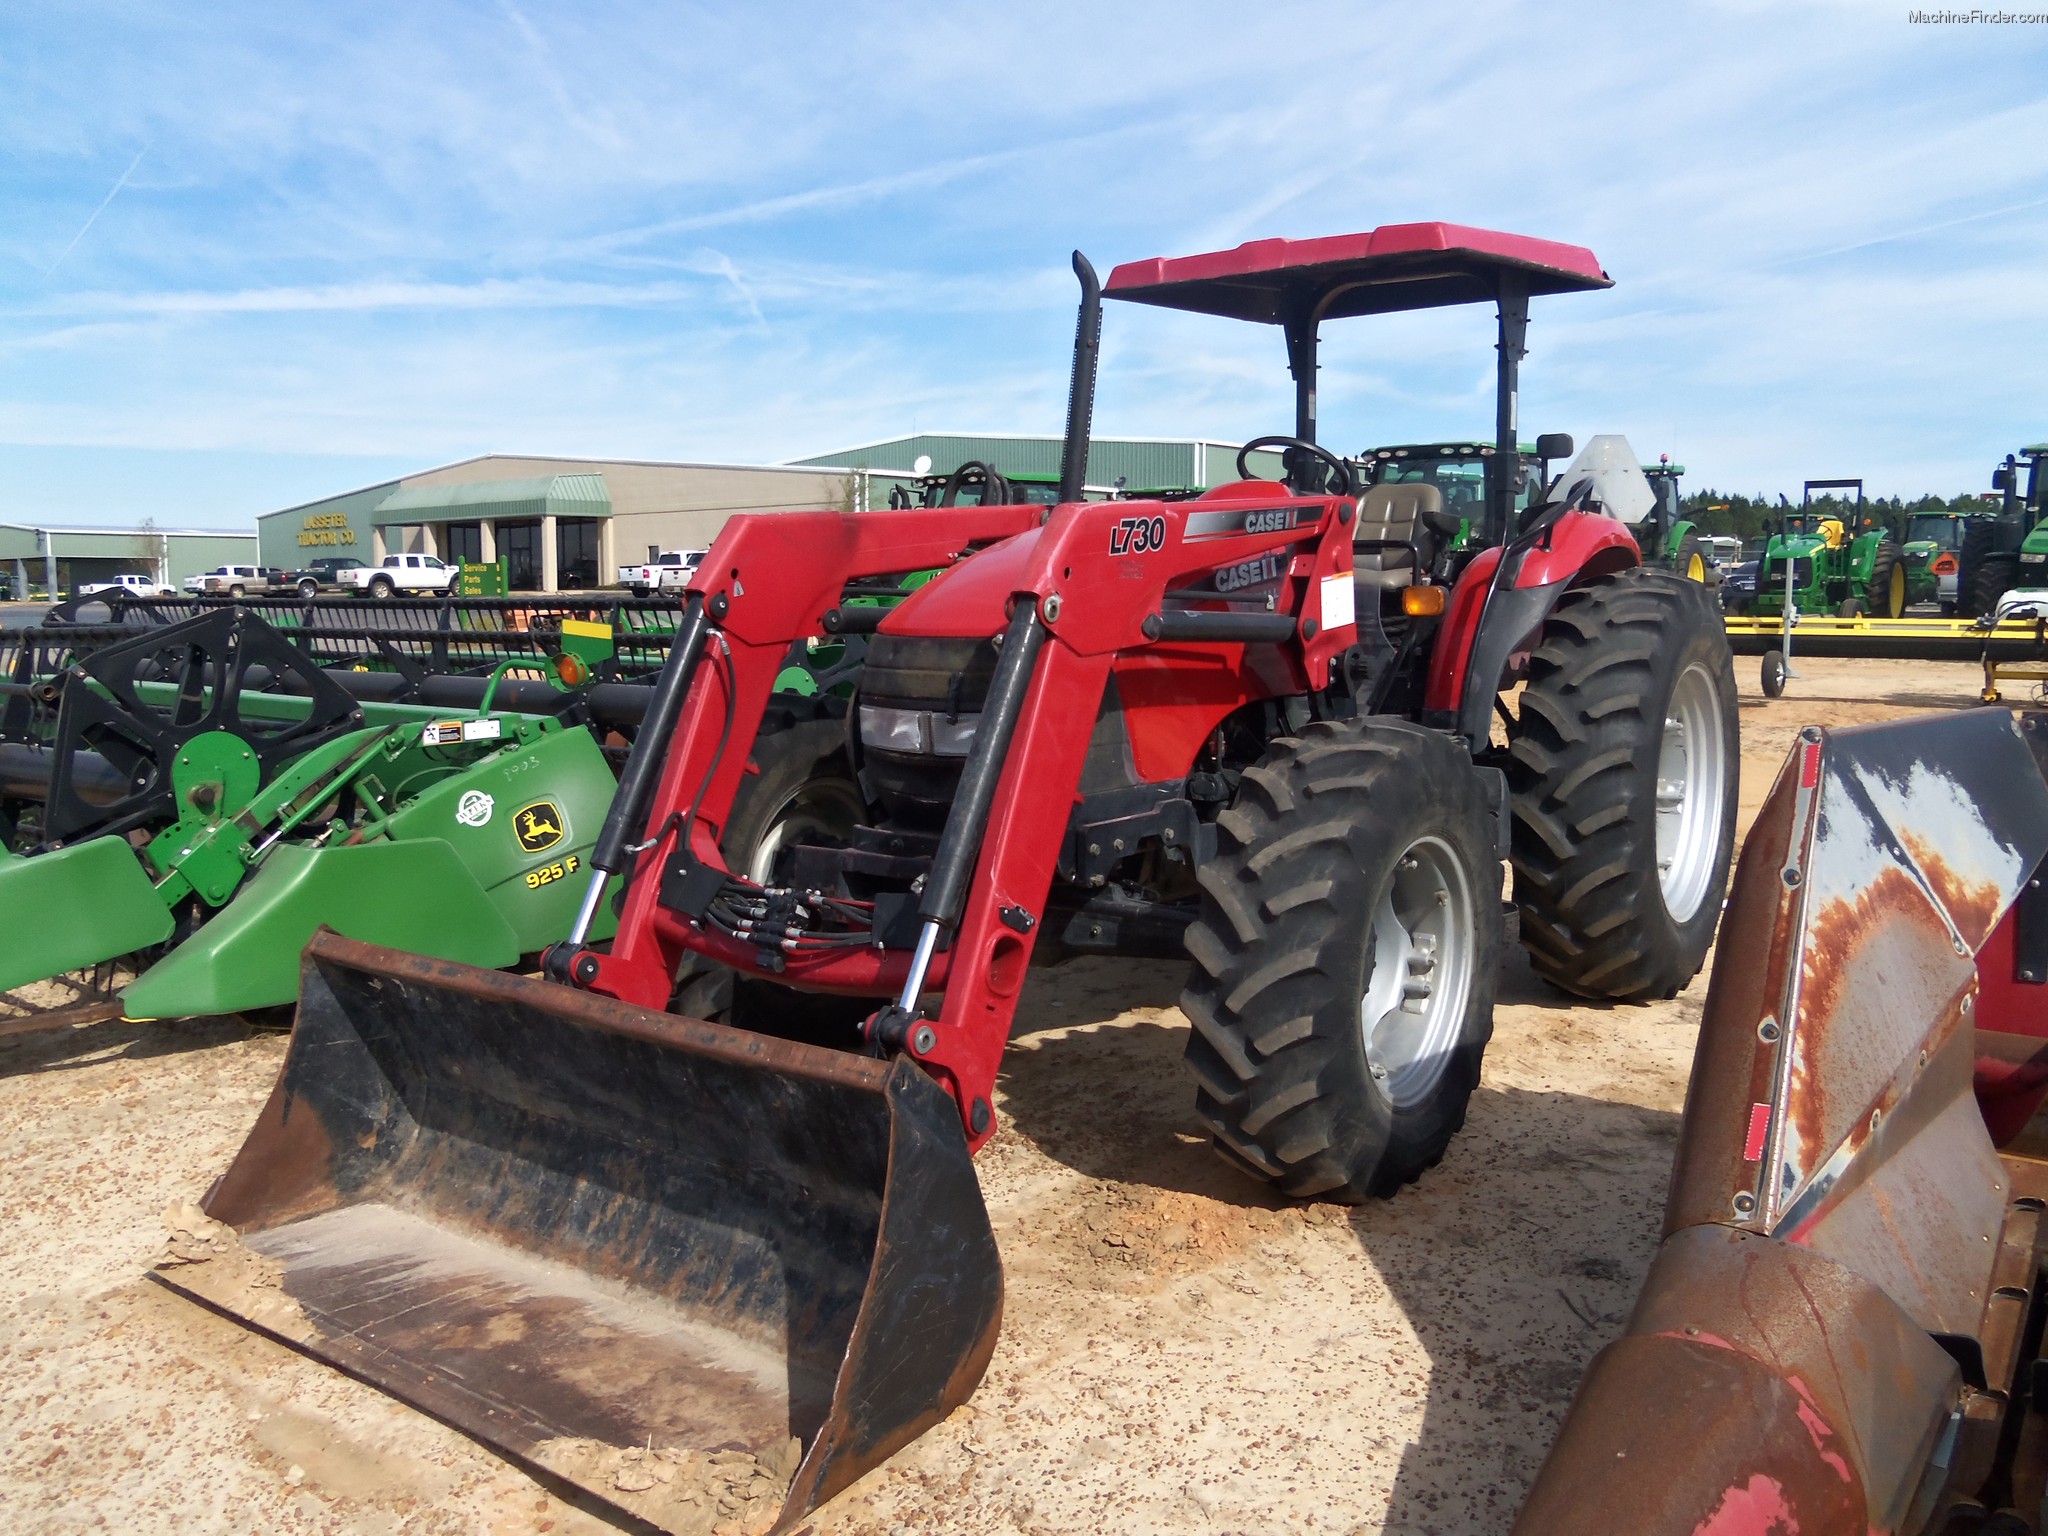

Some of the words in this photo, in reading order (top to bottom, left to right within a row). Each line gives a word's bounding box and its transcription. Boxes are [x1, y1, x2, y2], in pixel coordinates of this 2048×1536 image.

[298, 531, 337, 546] TRACTOR
[1109, 516, 1166, 556] L730
[464, 564, 487, 572] Service
[465, 587, 482, 595] Sales
[526, 863, 565, 890] 925
[566, 856, 580, 873] F
